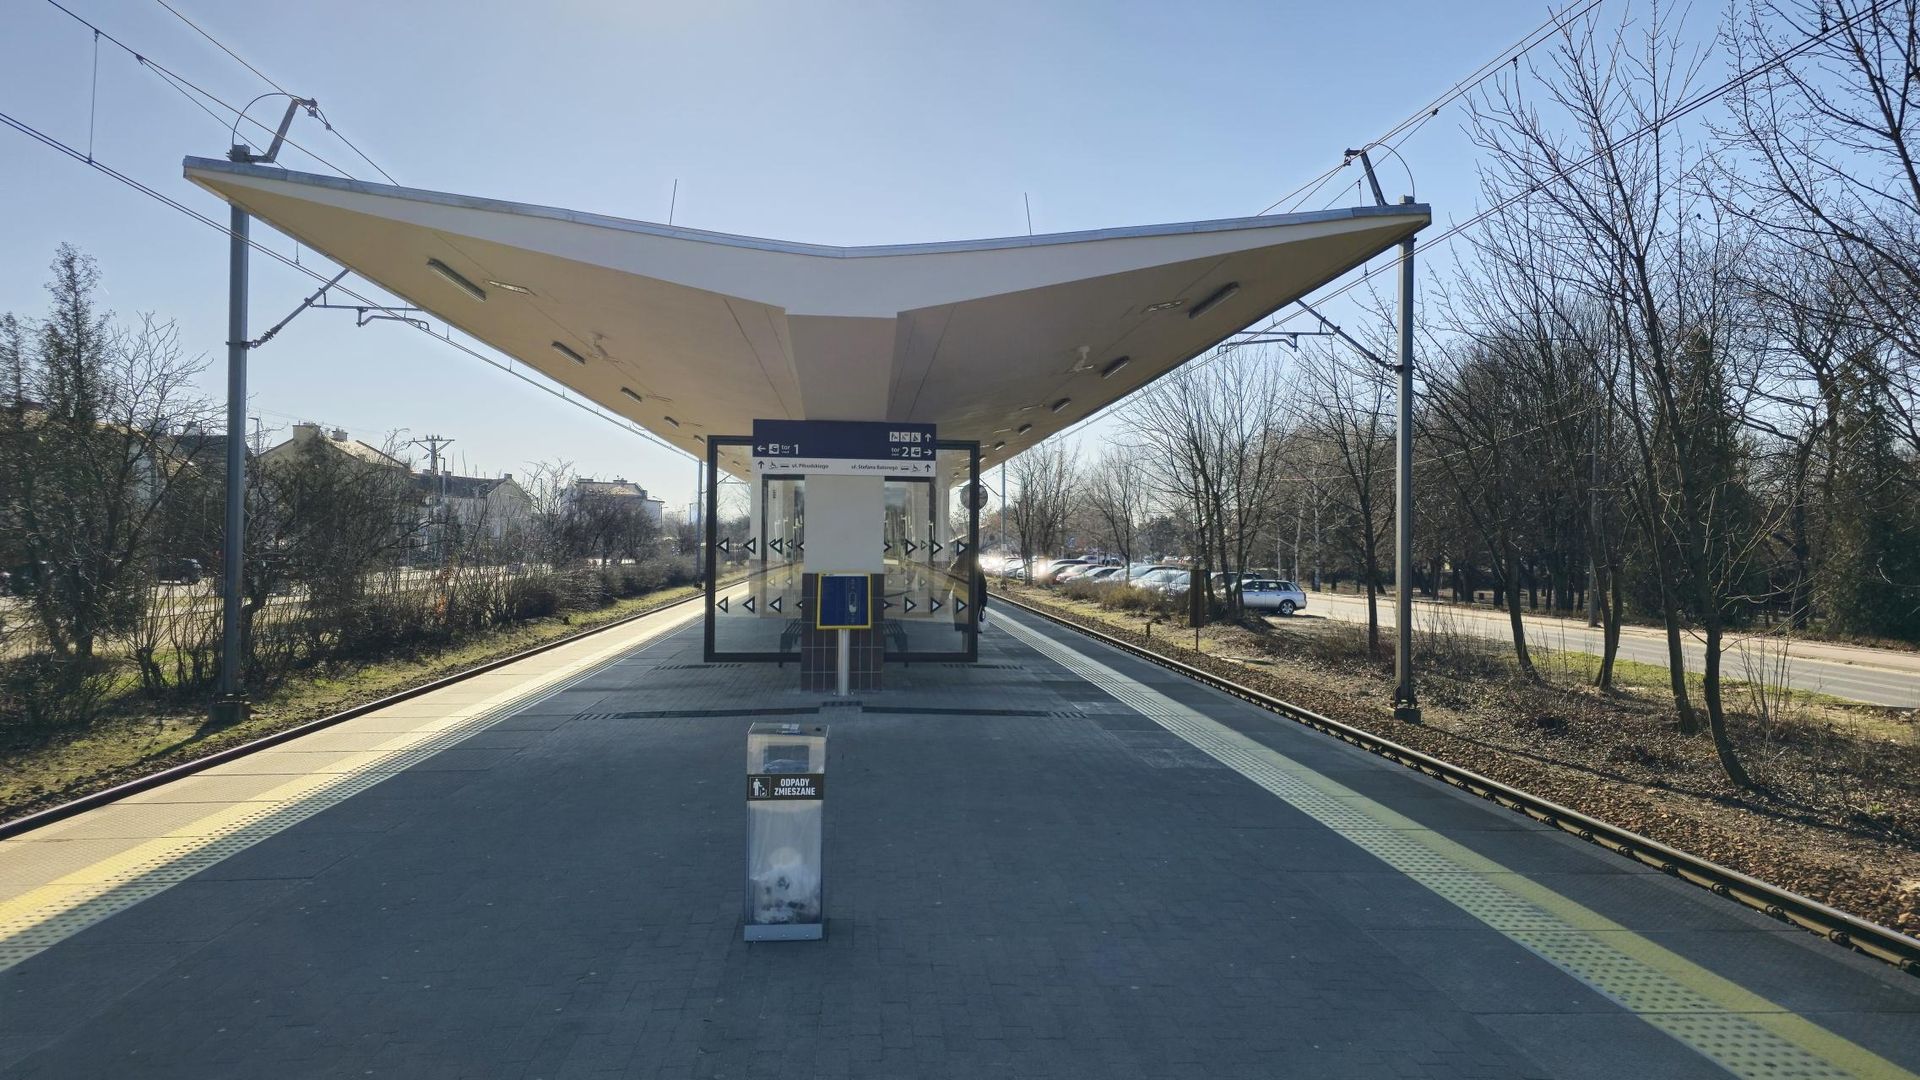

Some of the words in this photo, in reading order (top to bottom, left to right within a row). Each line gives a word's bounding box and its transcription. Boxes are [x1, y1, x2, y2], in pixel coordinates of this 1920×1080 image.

[793, 444, 799, 455] 1
[902, 446, 909, 457] 2
[780, 778, 810, 787] ODPADY
[774, 787, 816, 796] ZMIESZANE
